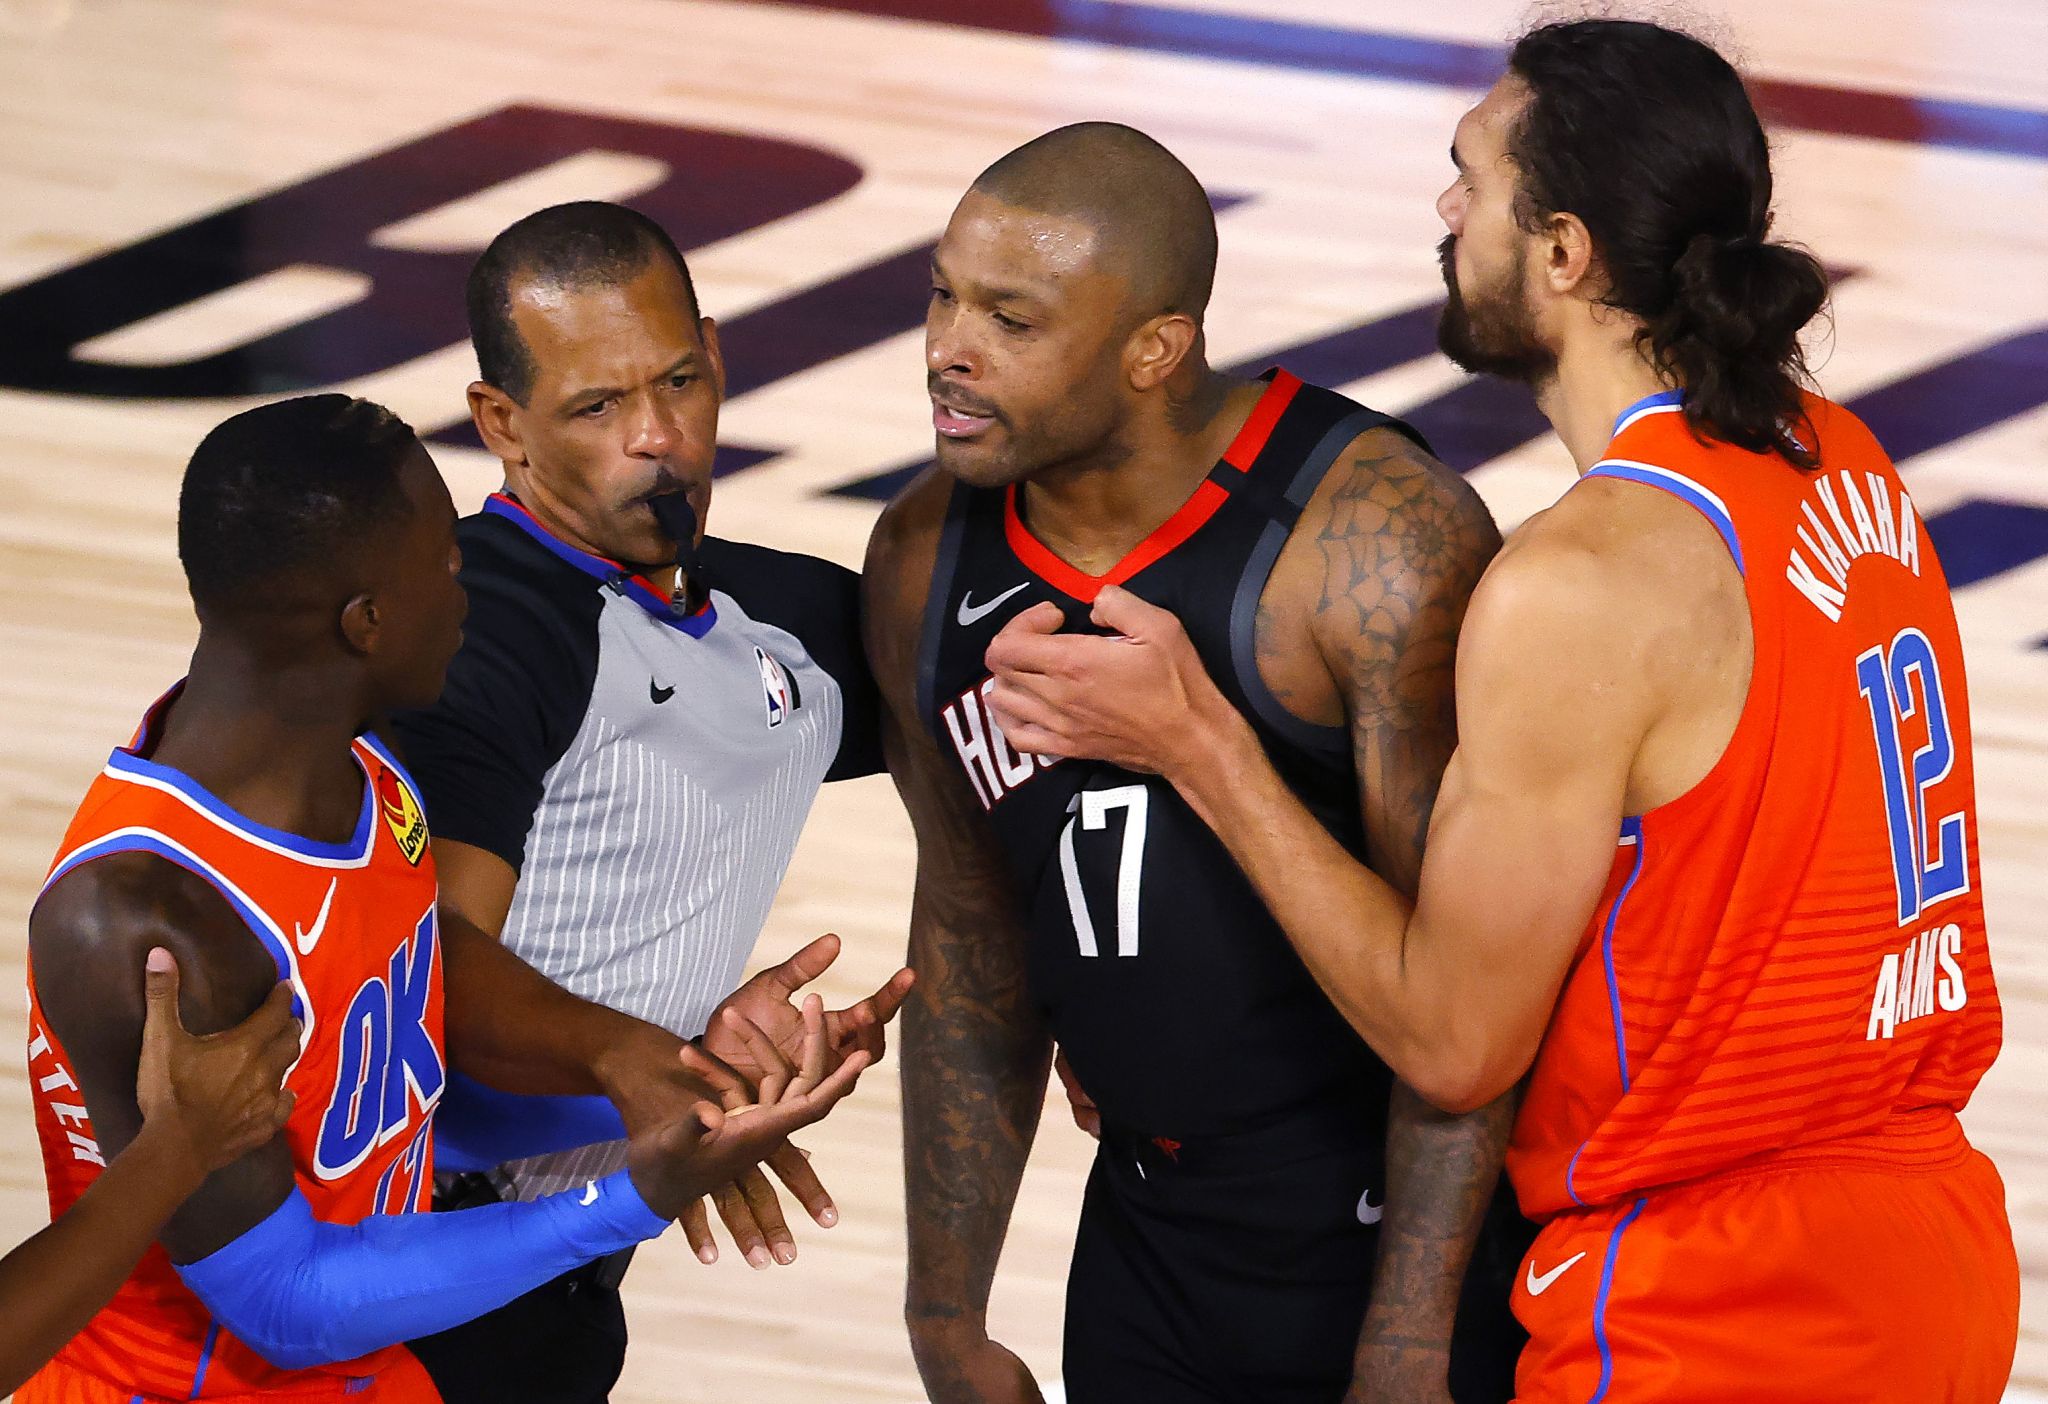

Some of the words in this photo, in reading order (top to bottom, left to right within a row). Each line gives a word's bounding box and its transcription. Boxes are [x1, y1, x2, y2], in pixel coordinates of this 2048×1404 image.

[1059, 784, 1149, 957] 17
[1856, 628, 1970, 928] 12
[313, 900, 446, 1181] OK
